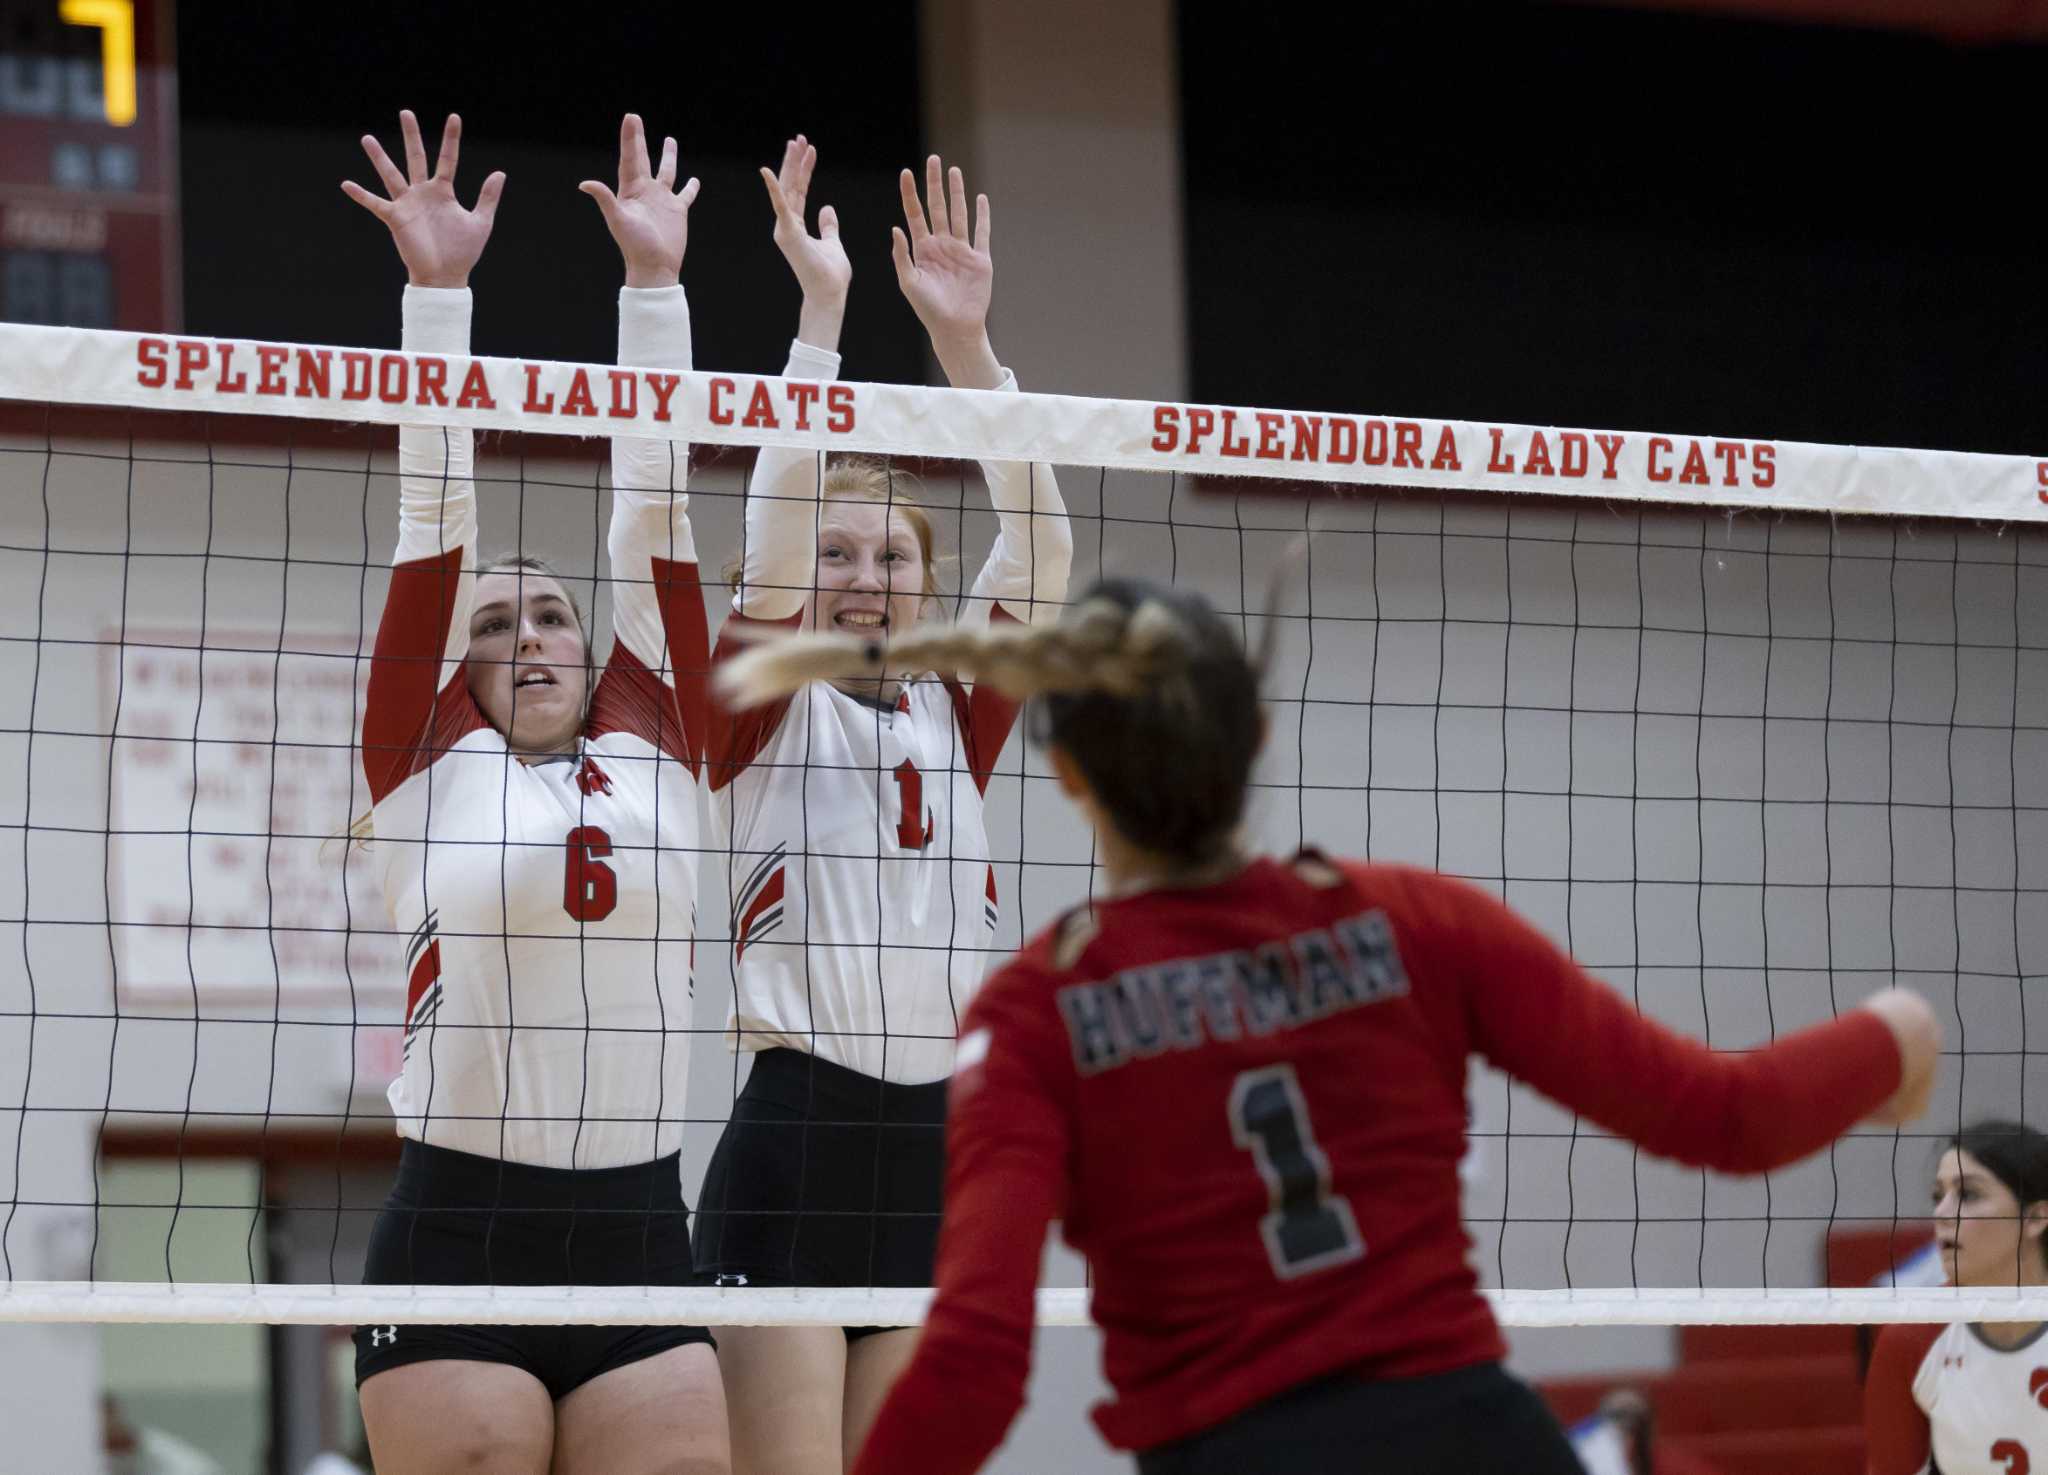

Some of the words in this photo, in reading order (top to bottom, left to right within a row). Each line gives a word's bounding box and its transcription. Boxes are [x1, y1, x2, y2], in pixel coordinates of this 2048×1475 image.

[137, 338, 497, 409] SPLENDORA
[522, 364, 682, 423] LADY
[708, 369, 856, 434] CATS
[1151, 406, 1463, 472] SPLENDORA
[1486, 428, 1624, 480] LADY
[1646, 437, 1777, 489] CATS
[894, 757, 934, 850] 1
[563, 825, 617, 922] 6
[1057, 911, 1410, 1076] HUFFMAN
[1228, 1064, 1364, 1280] 1
